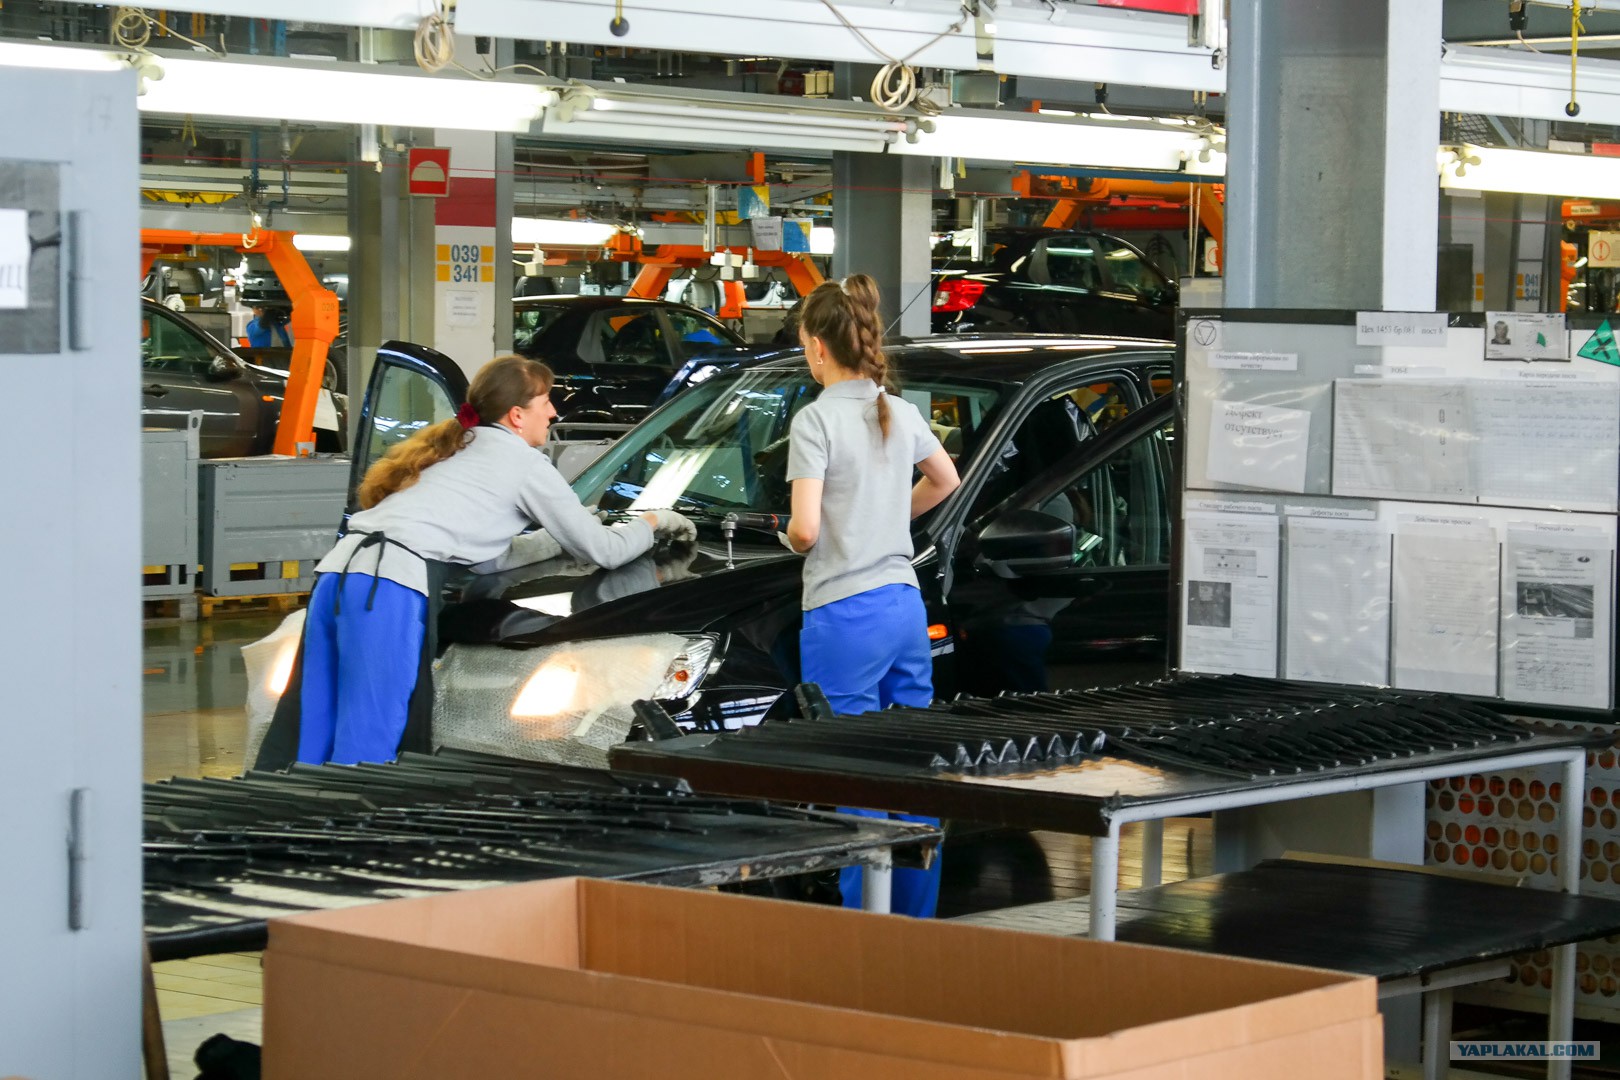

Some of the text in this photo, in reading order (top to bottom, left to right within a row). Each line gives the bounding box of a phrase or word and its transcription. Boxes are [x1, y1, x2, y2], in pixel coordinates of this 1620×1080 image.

[451, 244, 480, 264] 039
[453, 264, 479, 283] 341
[1525, 273, 1538, 287] 041
